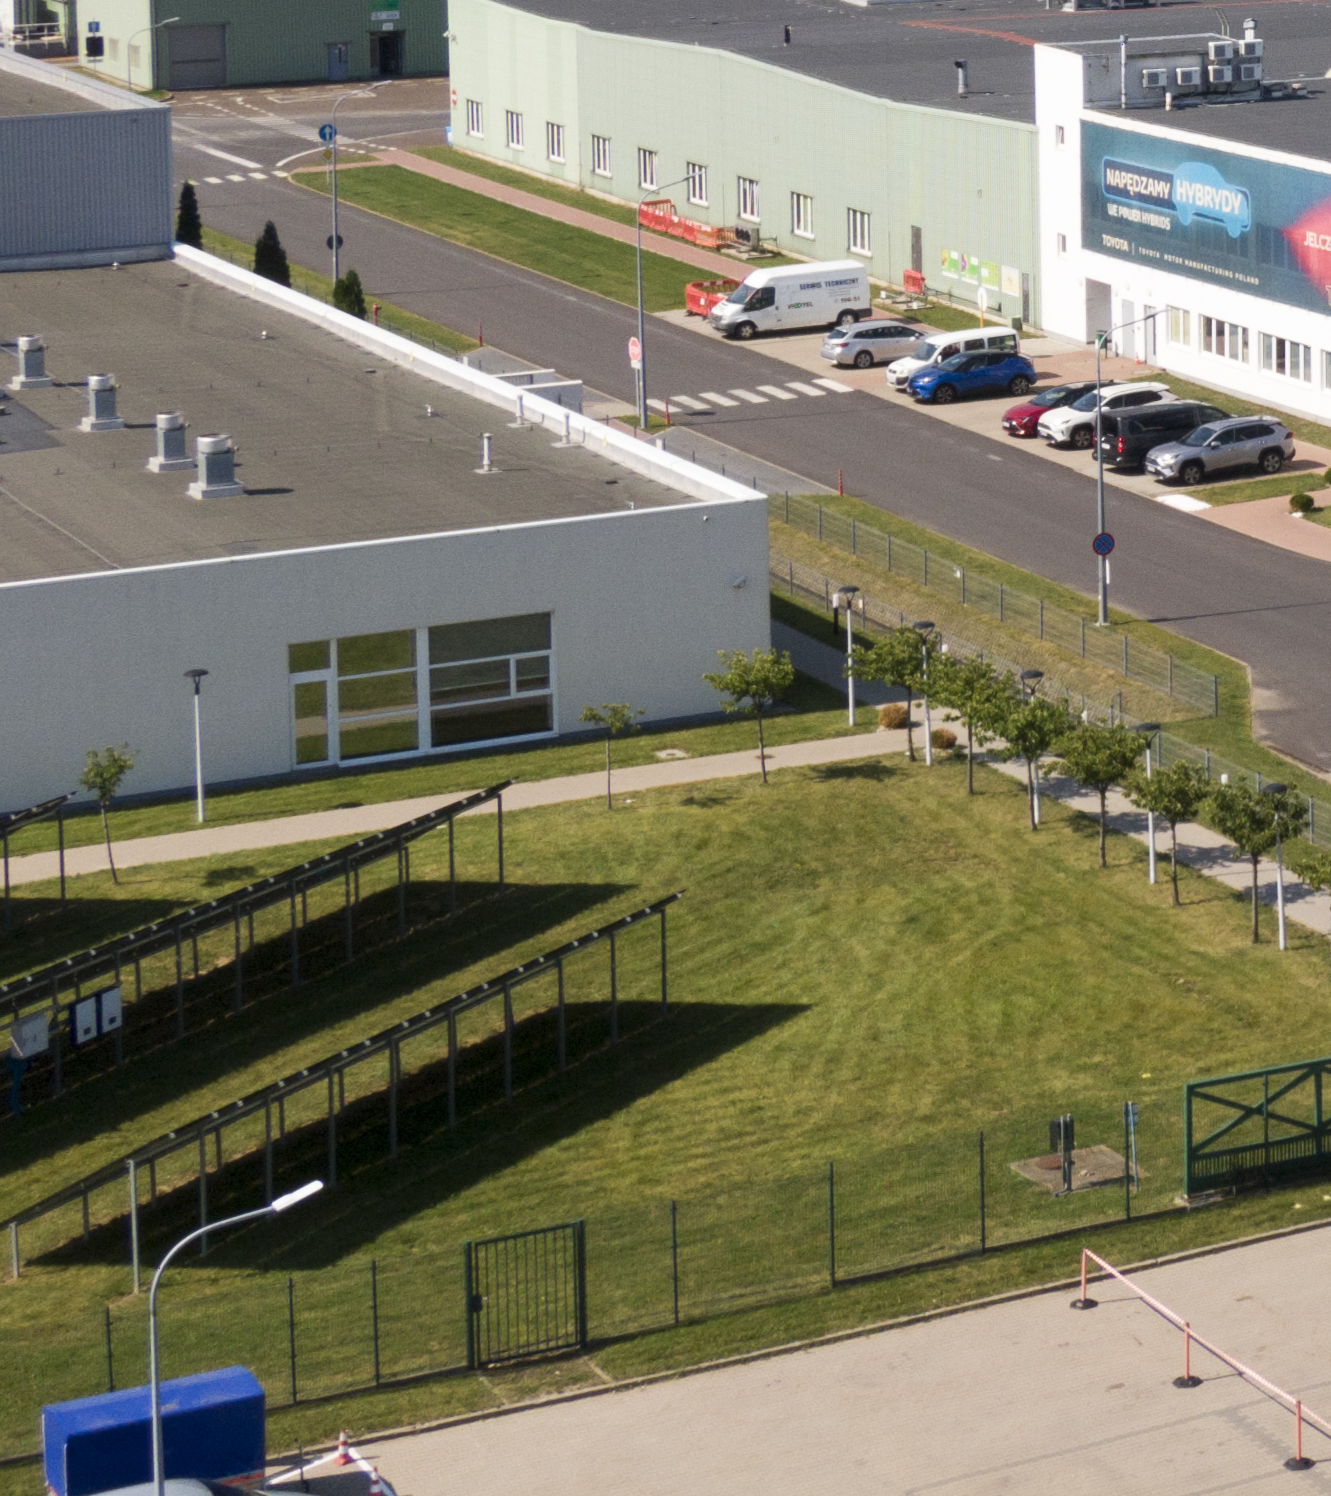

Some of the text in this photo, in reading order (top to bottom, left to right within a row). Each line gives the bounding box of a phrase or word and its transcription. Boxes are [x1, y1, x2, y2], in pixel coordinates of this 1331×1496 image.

[1106, 168, 1242, 215] NAPĘDZAMY HYBRYDY
[1118, 206, 1141, 223] POWER
[1141, 211, 1171, 230] HYBRIDS
[1102, 234, 1129, 252] TOYOTA
[1138, 247, 1259, 285] TOYOTA MOTOR MANUFACTURING POLAND
